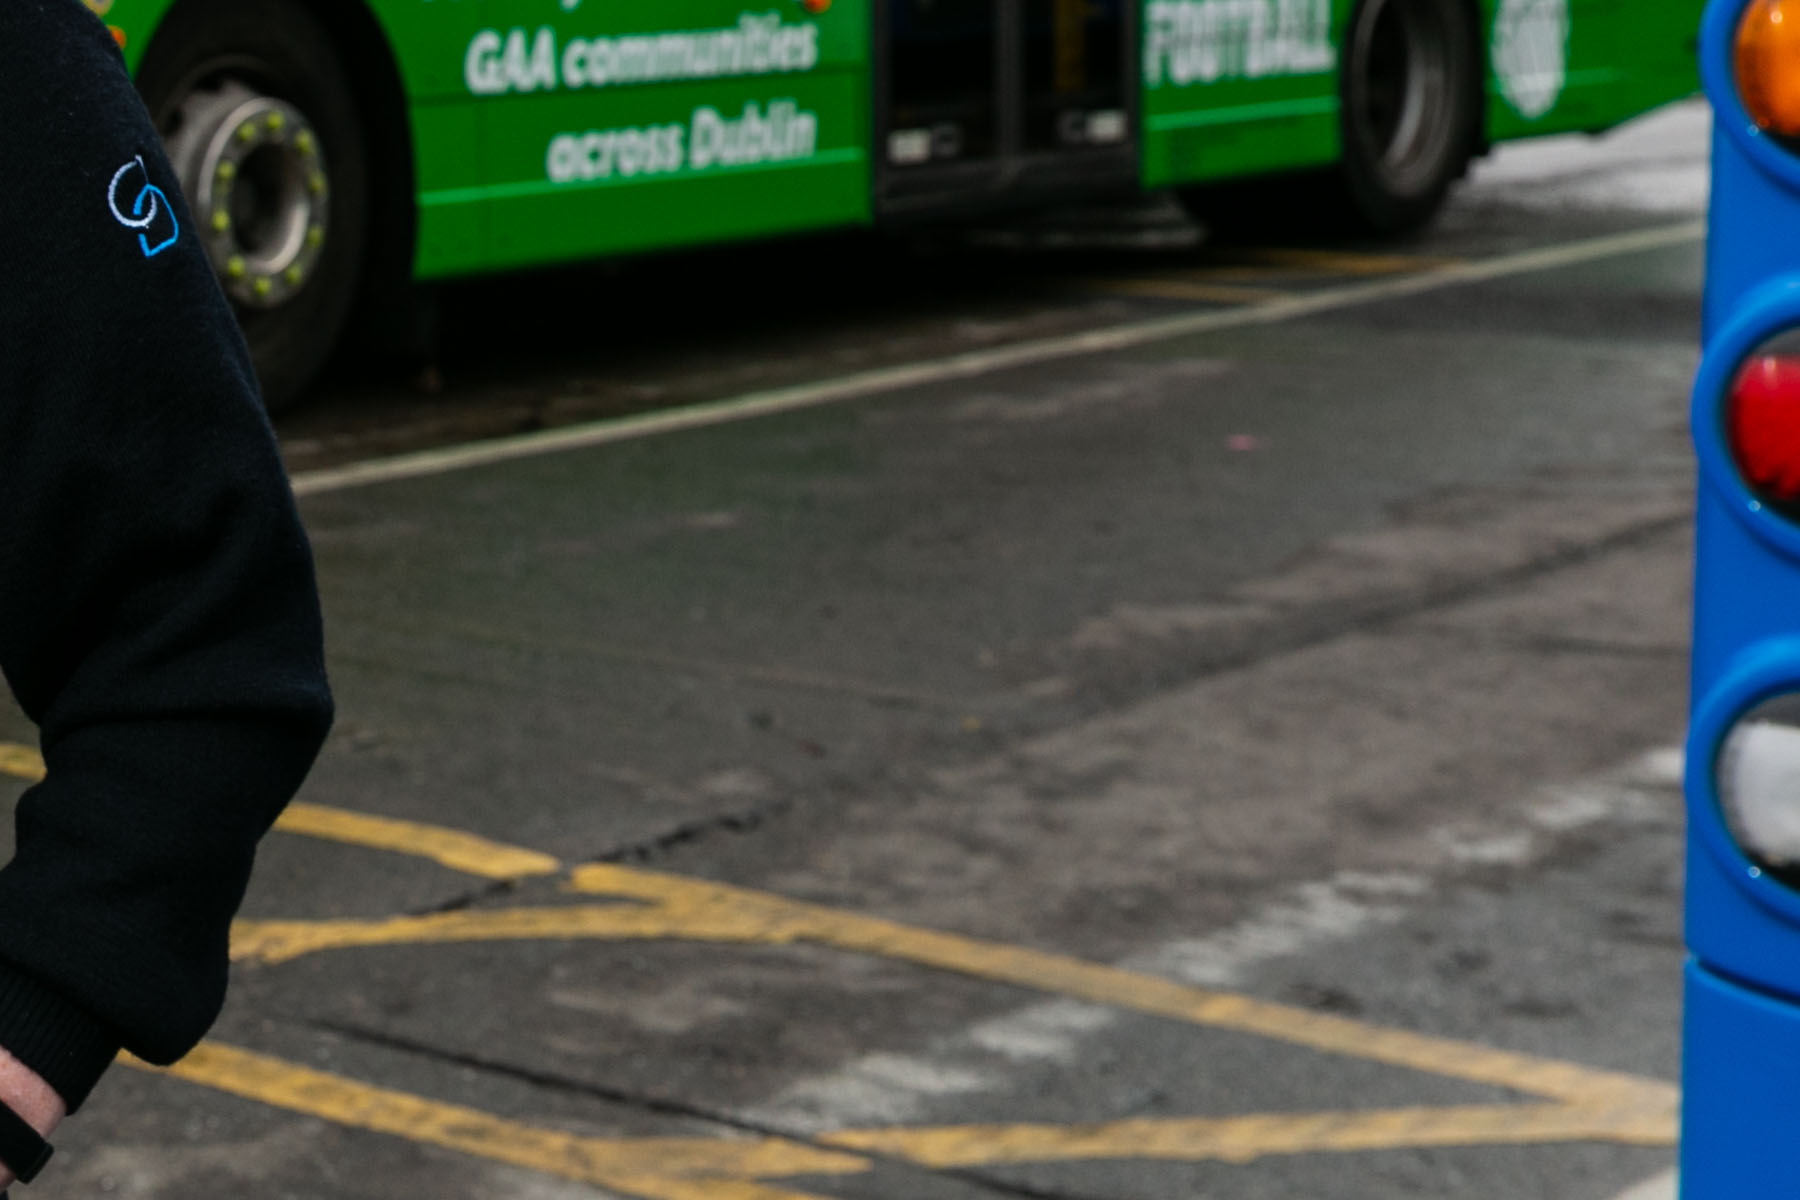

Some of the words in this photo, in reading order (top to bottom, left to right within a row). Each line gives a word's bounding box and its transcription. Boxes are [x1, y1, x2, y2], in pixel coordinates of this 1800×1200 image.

[465, 26, 557, 95] GAA
[563, 12, 819, 87] communities
[547, 120, 681, 184] across
[688, 100, 818, 172] Dublin
